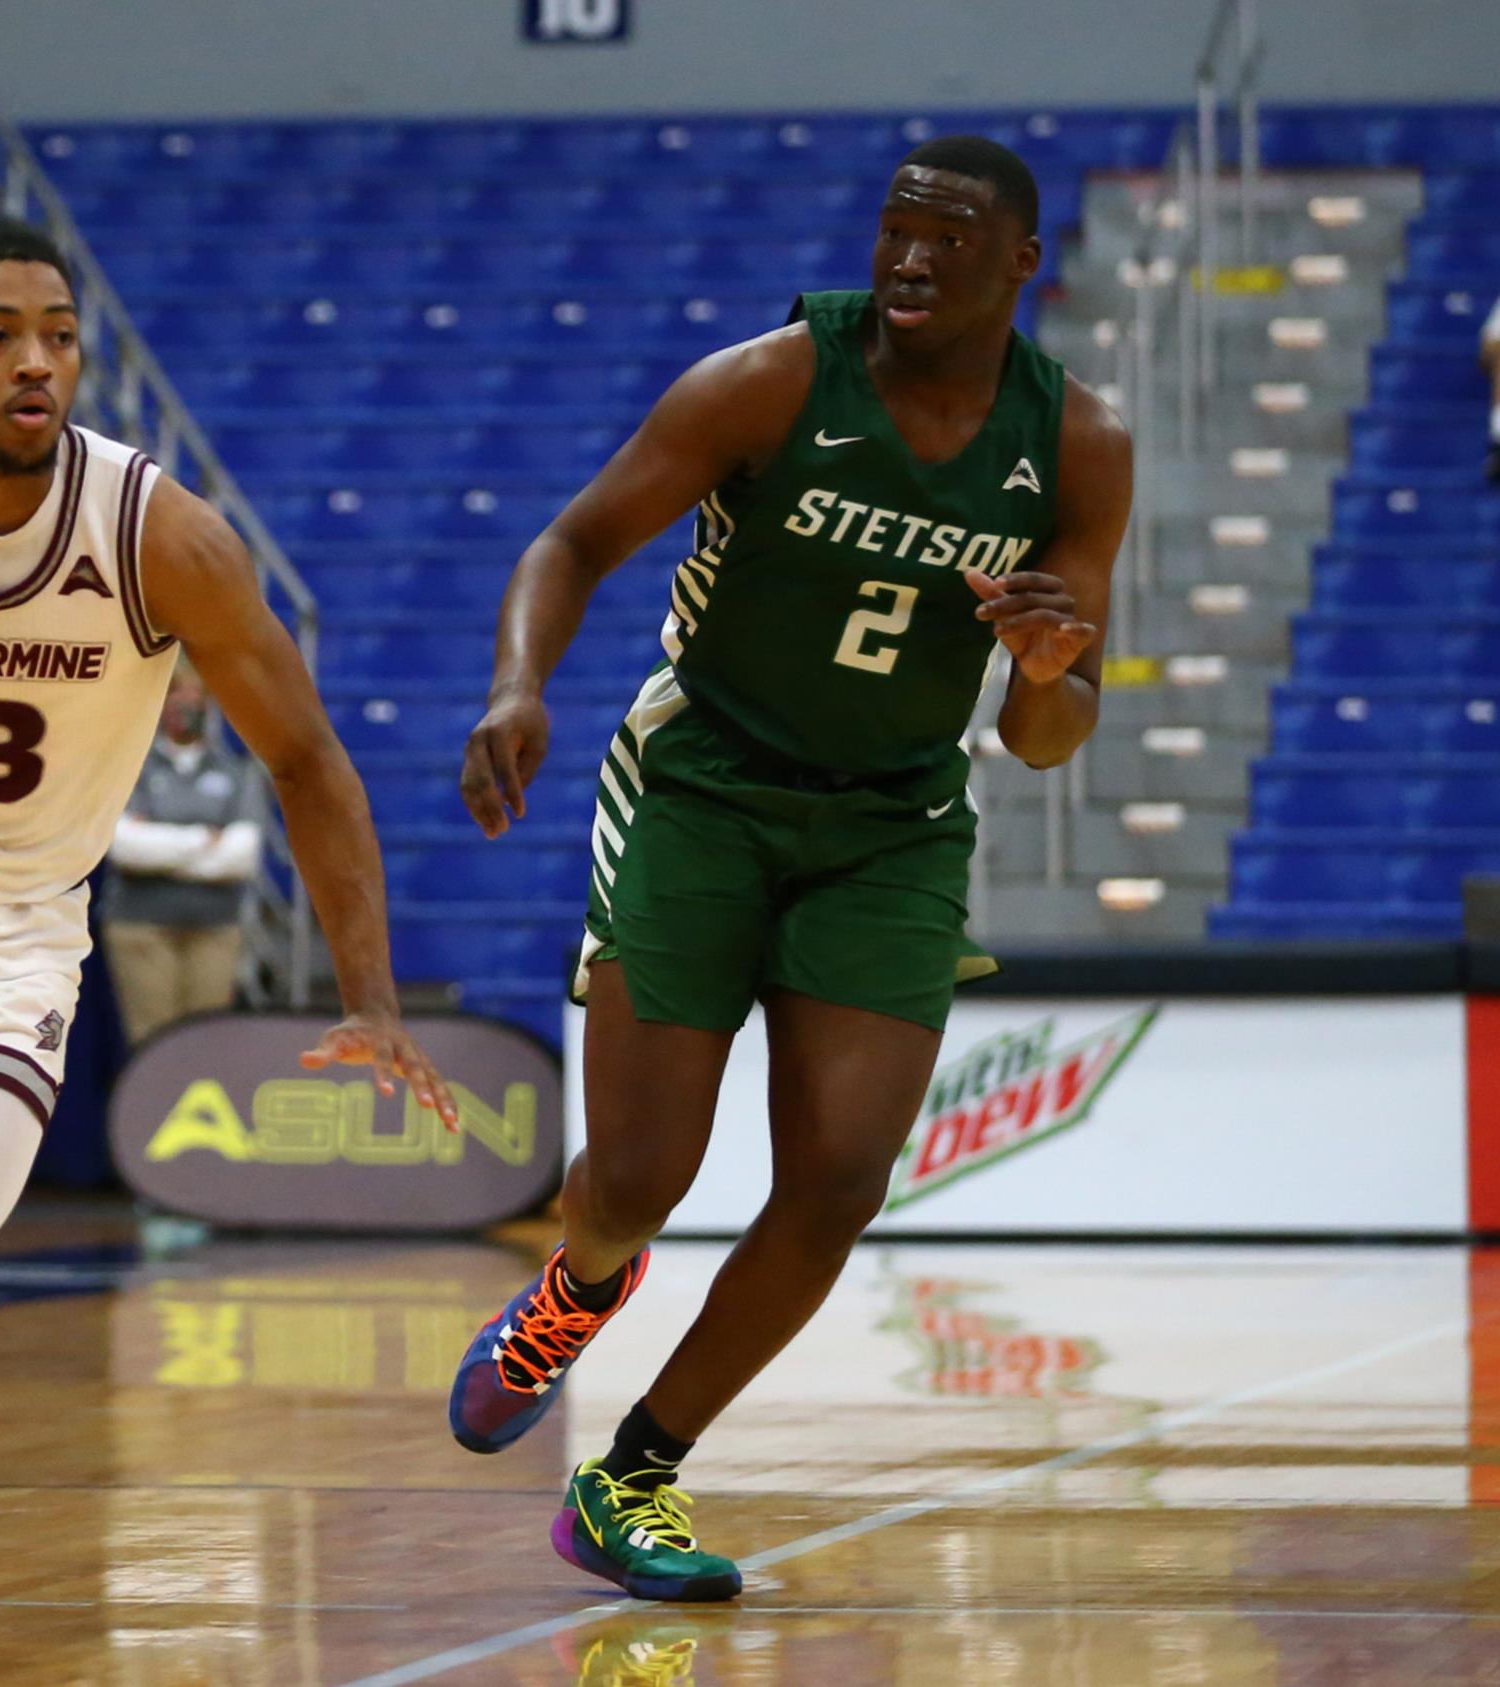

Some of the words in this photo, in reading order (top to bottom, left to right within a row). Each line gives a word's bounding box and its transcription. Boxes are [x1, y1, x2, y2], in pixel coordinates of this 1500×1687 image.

[783, 488, 1033, 577] STETSON
[833, 580, 919, 675] 2
[145, 1078, 538, 1166] ASUN
